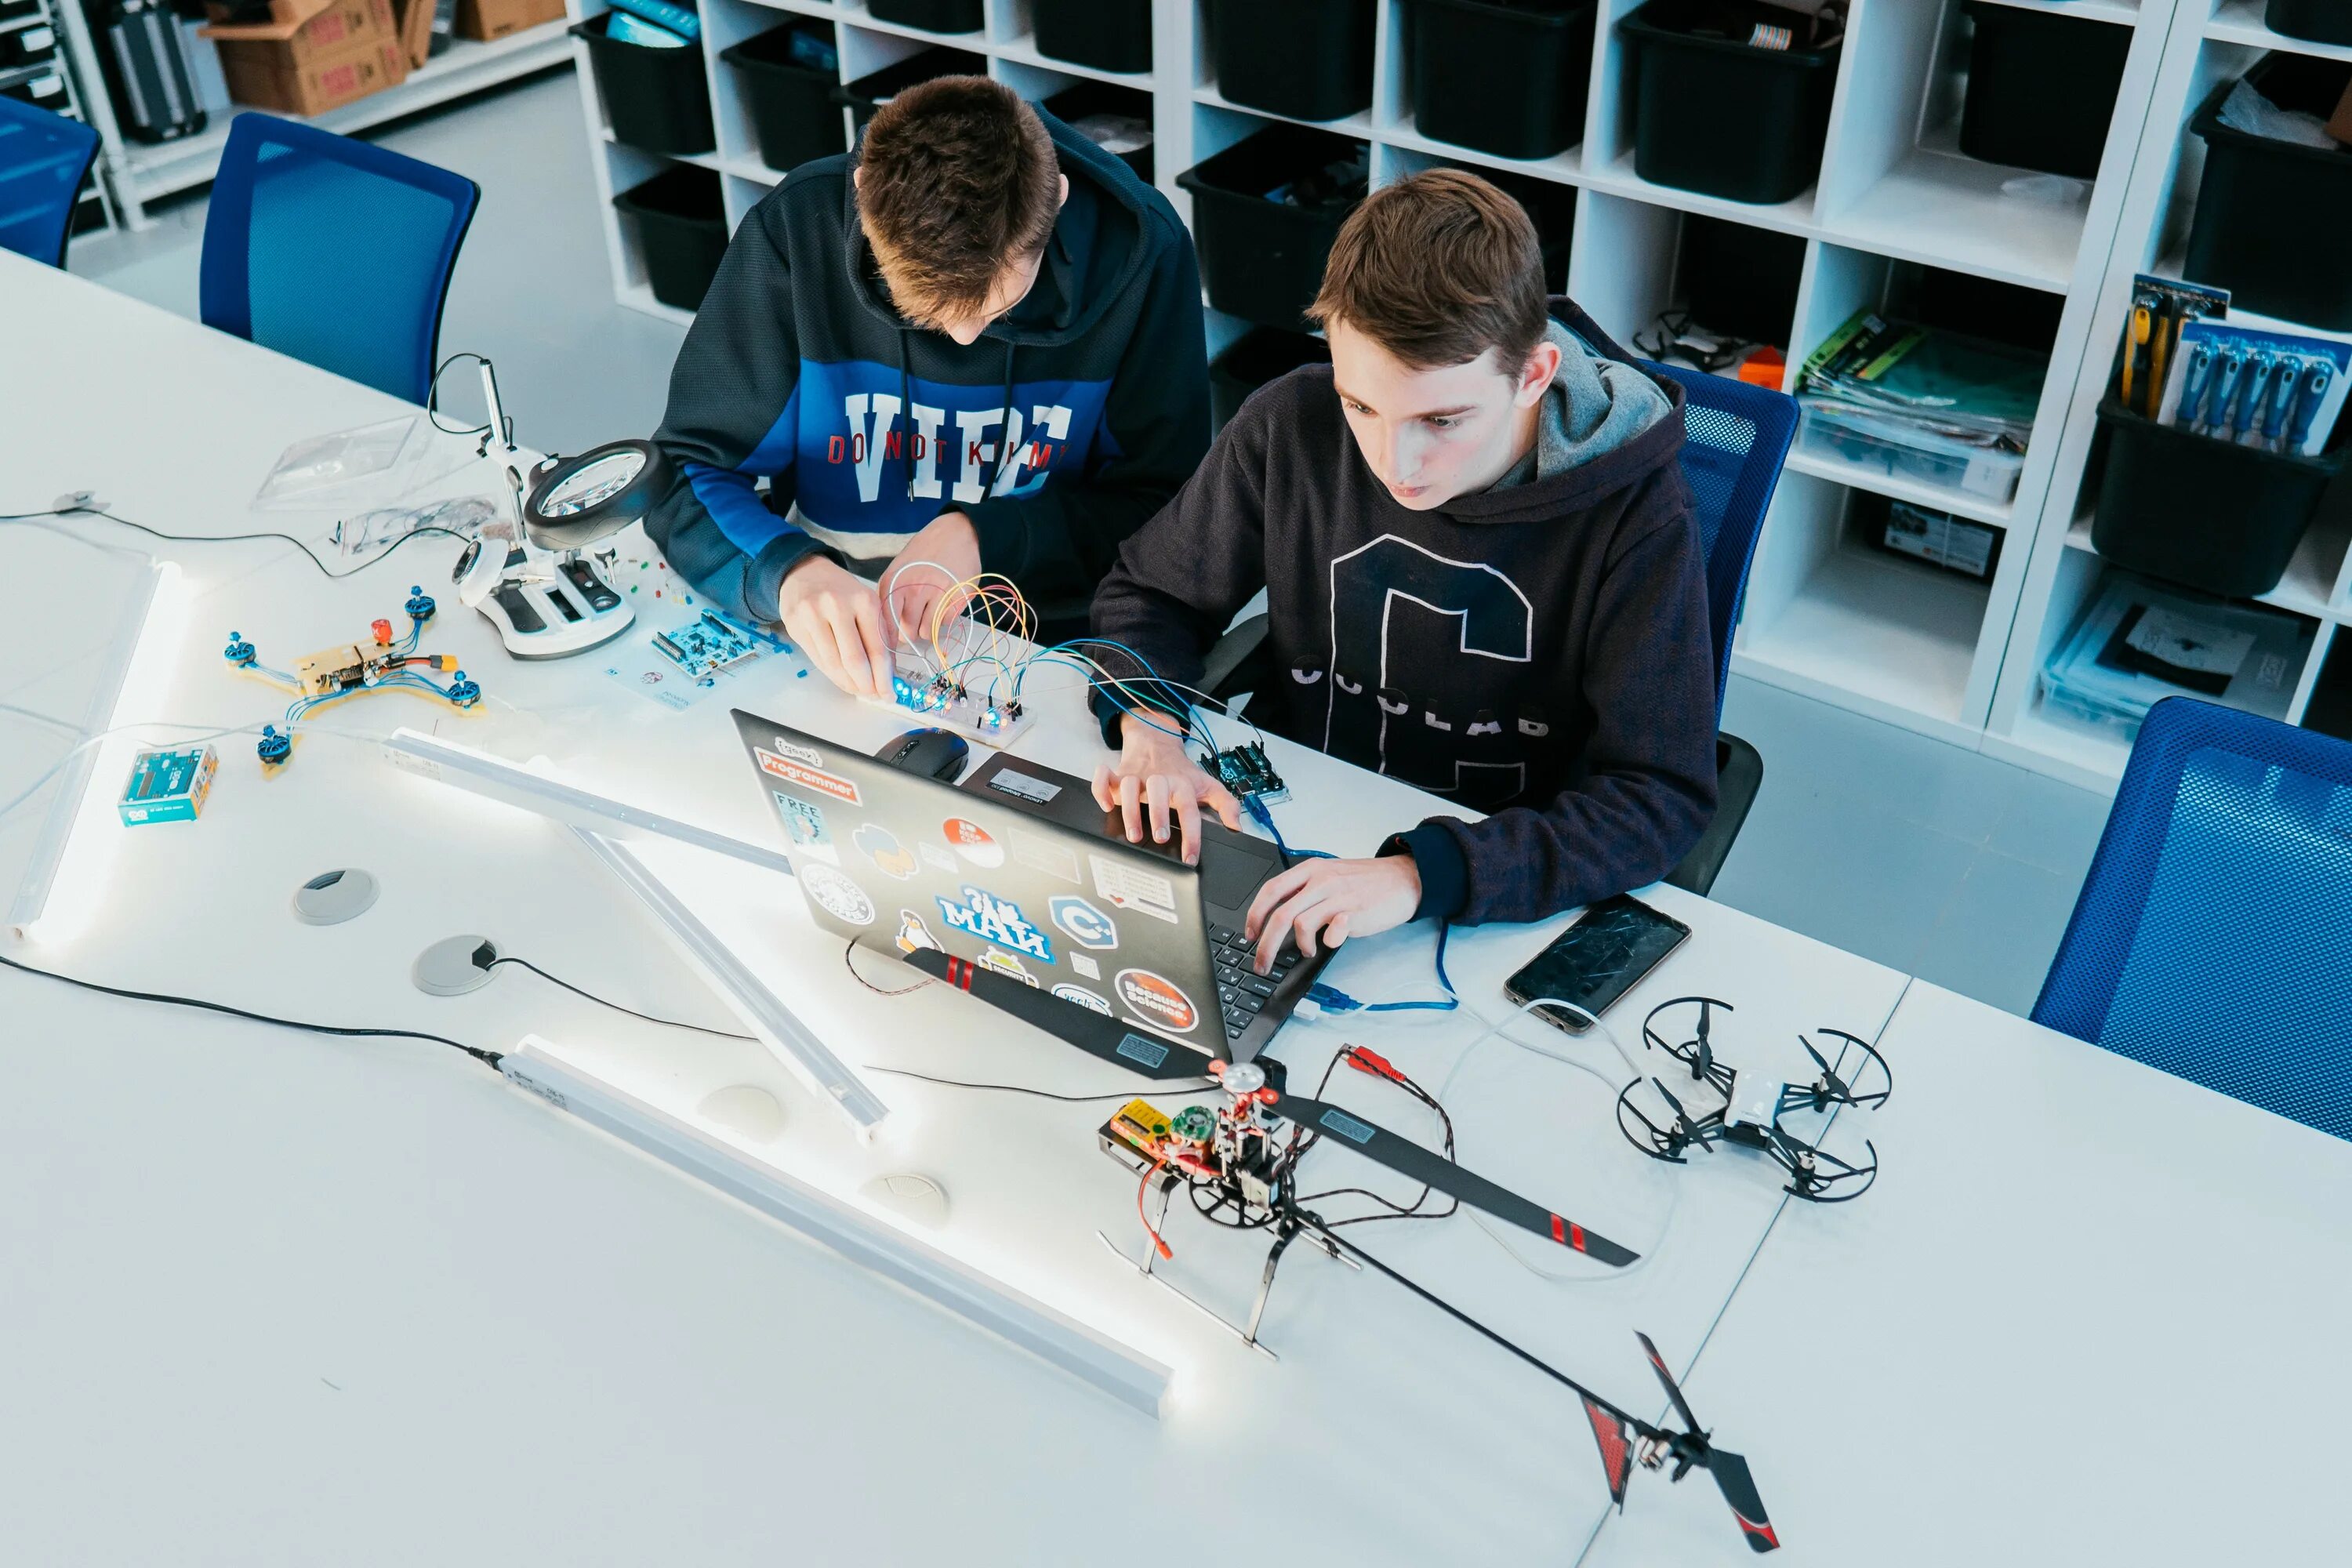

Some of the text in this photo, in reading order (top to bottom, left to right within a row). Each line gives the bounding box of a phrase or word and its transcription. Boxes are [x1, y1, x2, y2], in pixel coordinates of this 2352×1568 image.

[828, 433, 864, 464] DO
[885, 430, 947, 463] NOT
[762, 754, 852, 795] Programmer
[777, 795, 820, 818] FREE
[1124, 980, 1187, 1011] Because
